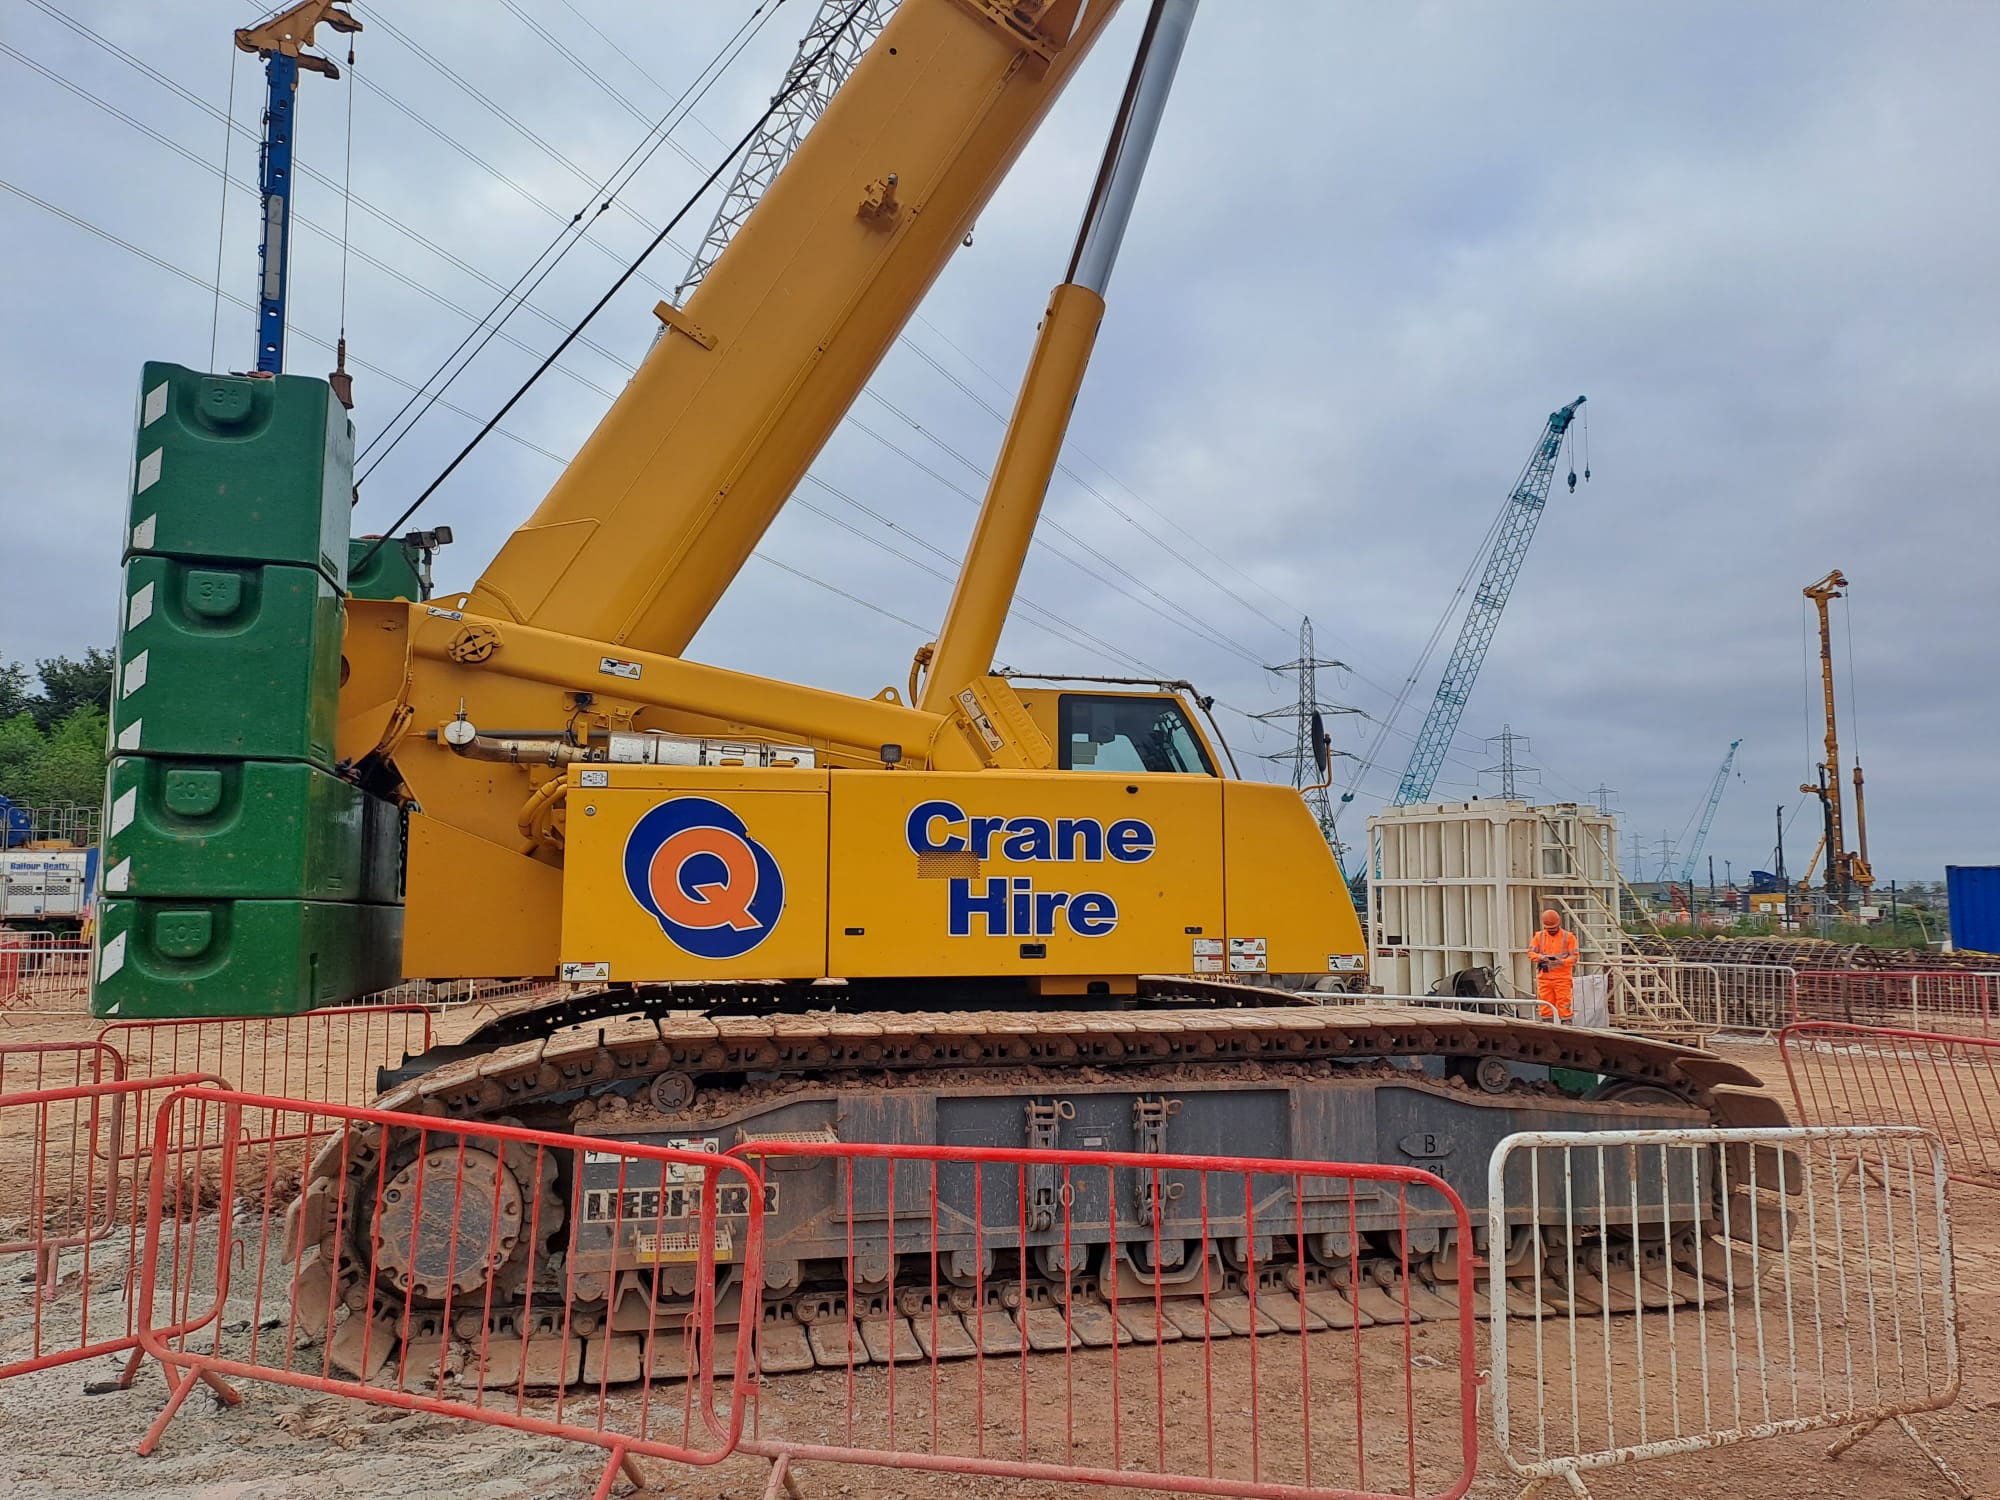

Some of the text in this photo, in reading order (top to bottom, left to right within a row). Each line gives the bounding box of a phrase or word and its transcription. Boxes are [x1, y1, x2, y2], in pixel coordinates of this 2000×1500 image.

[905, 799, 1156, 864] Crane
[10, 862, 40, 870] Balfour
[648, 825, 764, 932] Q
[947, 876, 1118, 938] Hire
[1424, 1134, 1436, 1153] B
